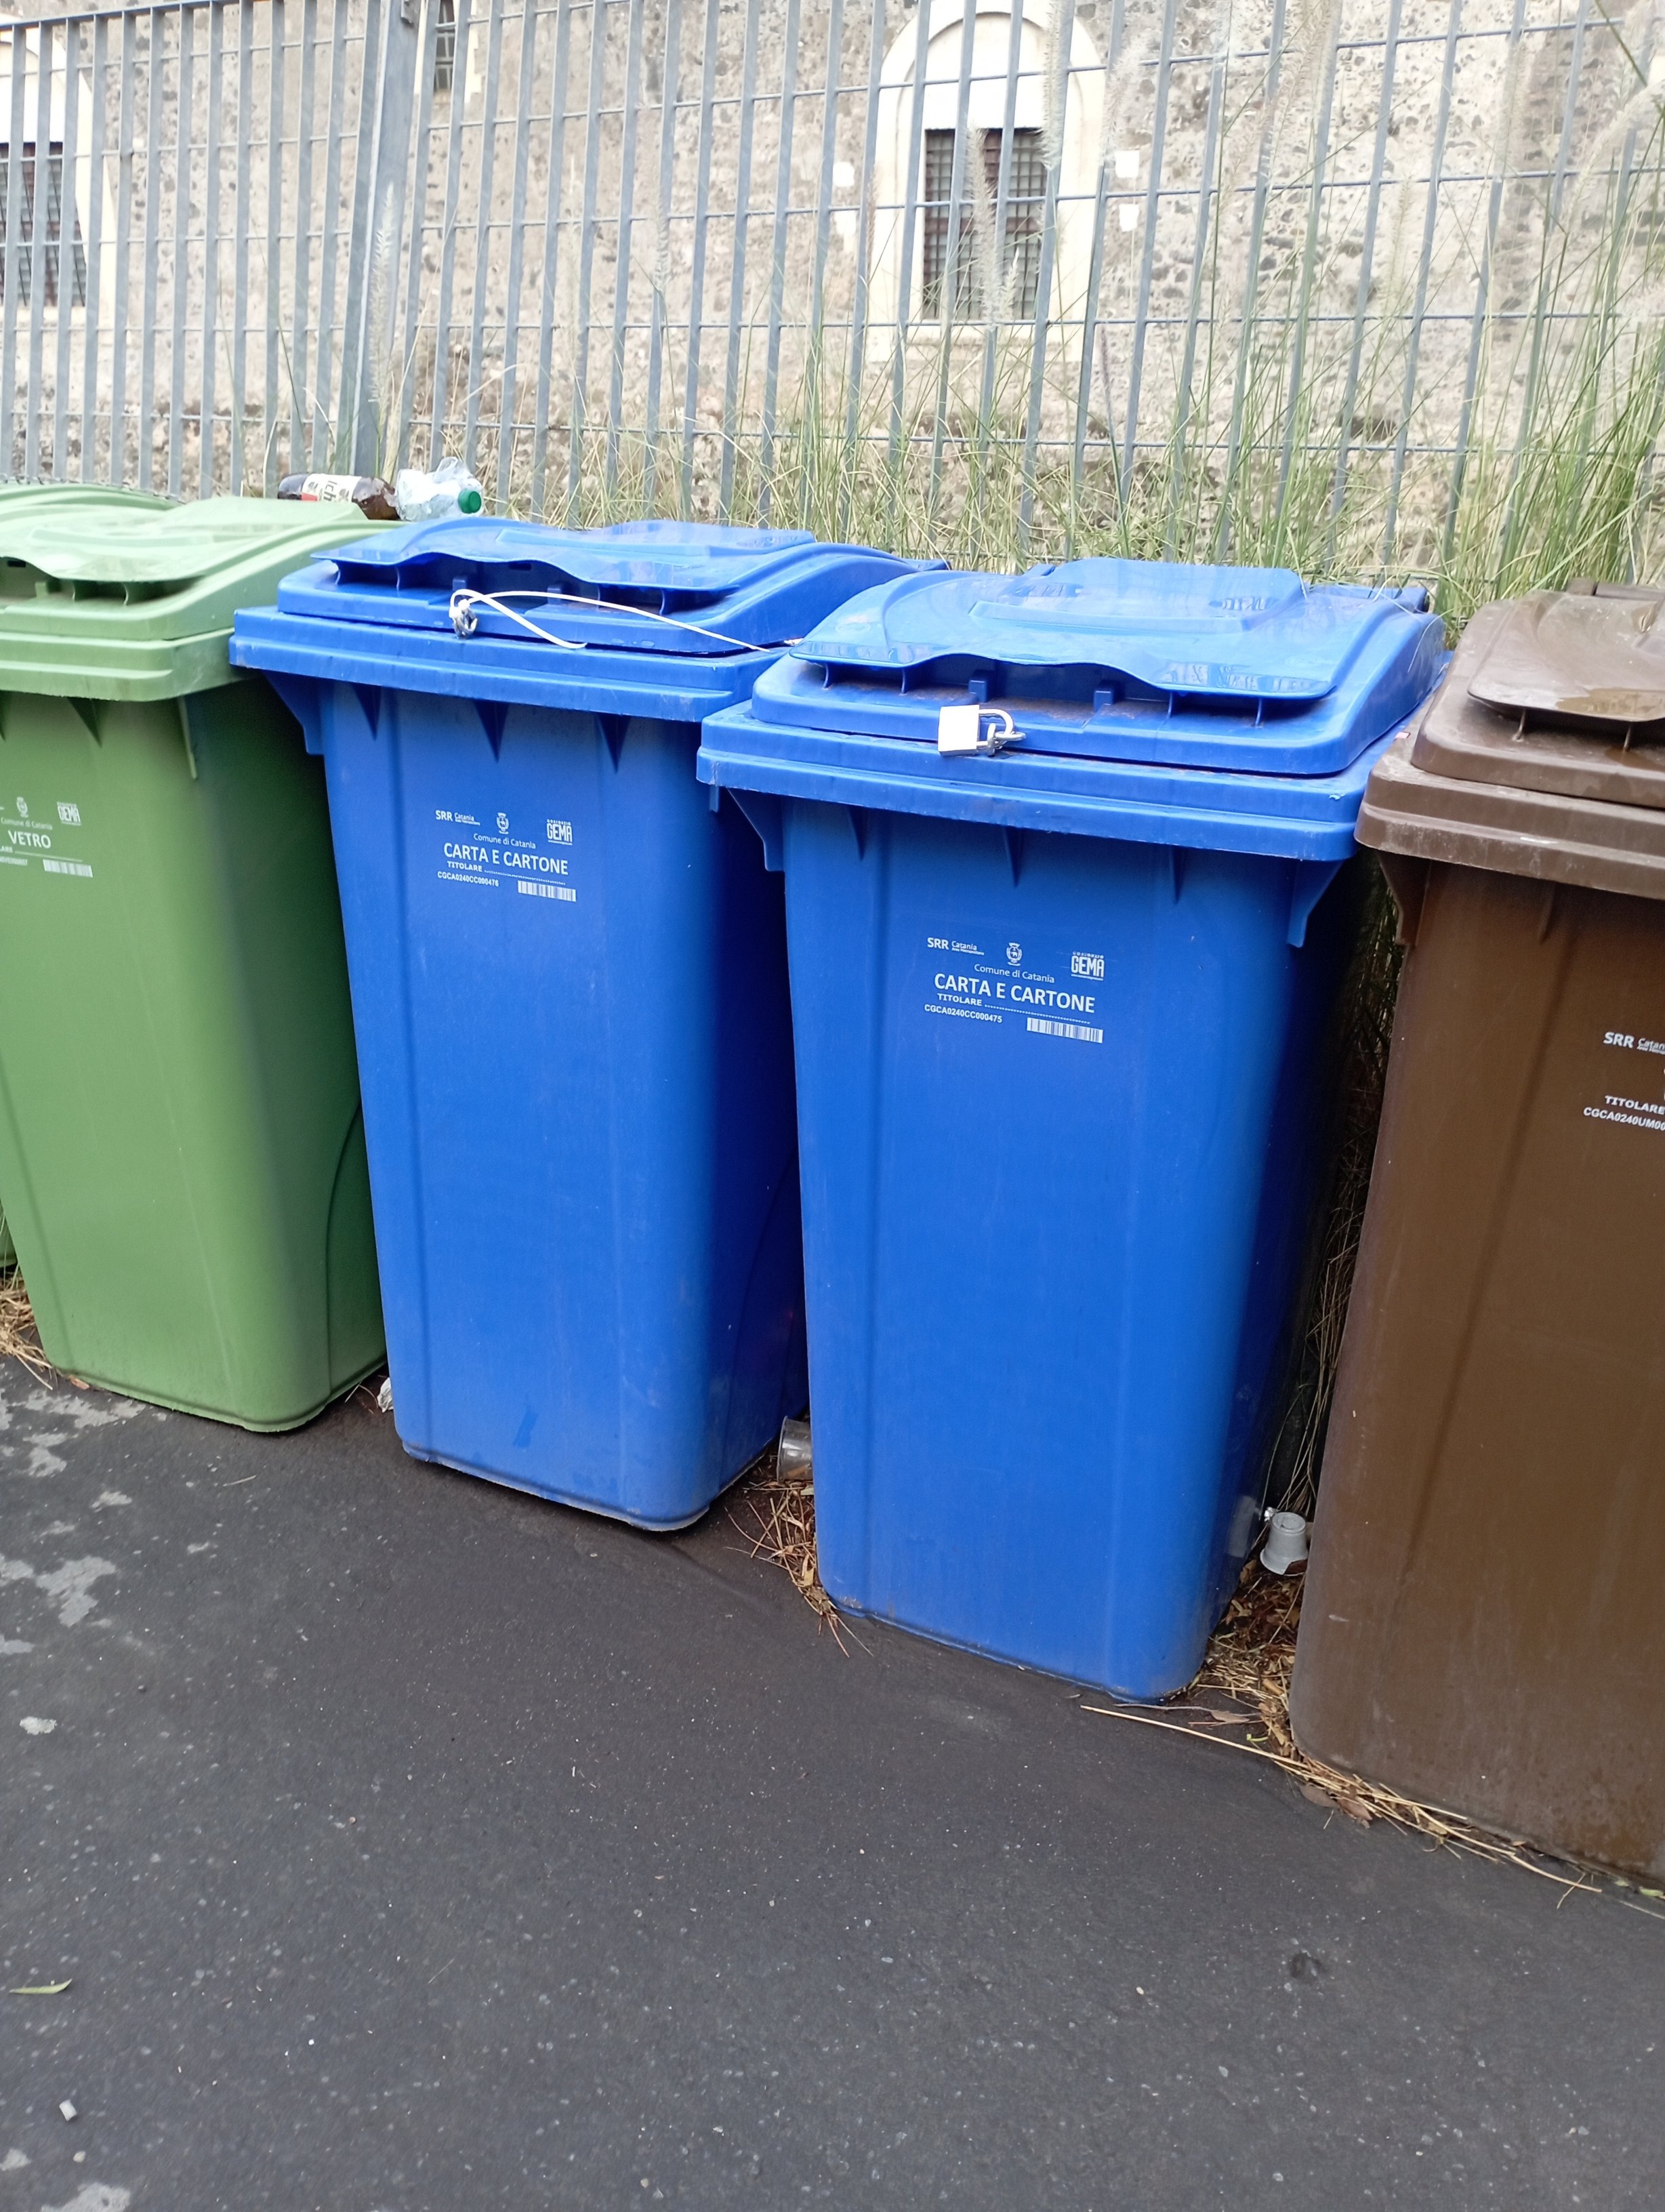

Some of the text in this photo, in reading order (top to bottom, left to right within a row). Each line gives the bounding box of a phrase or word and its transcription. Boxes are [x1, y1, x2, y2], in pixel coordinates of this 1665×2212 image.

[435, 809, 453, 822] SRR
[8, 830, 52, 848] VETRO
[473, 833, 501, 844] Comune
[503, 837, 509, 845] di
[510, 838, 536, 849] Catania
[546, 823, 573, 842] GEMA
[444, 842, 569, 875] CARTA E CARTONE
[447, 861, 482, 872] TITOLARE
[927, 937, 977, 951] SRR Catania
[974, 964, 1054, 983] Comune di Catania
[1071, 955, 1105, 978] GEMA
[934, 973, 1095, 1013] CARTA E CARTONE
[937, 993, 983, 1006] TITOLARE
[924, 1004, 1003, 1023] CGCA0240CC000475
[1603, 1031, 1635, 1048] SRR
[1605, 1095, 1665, 1115] TITOLARE
